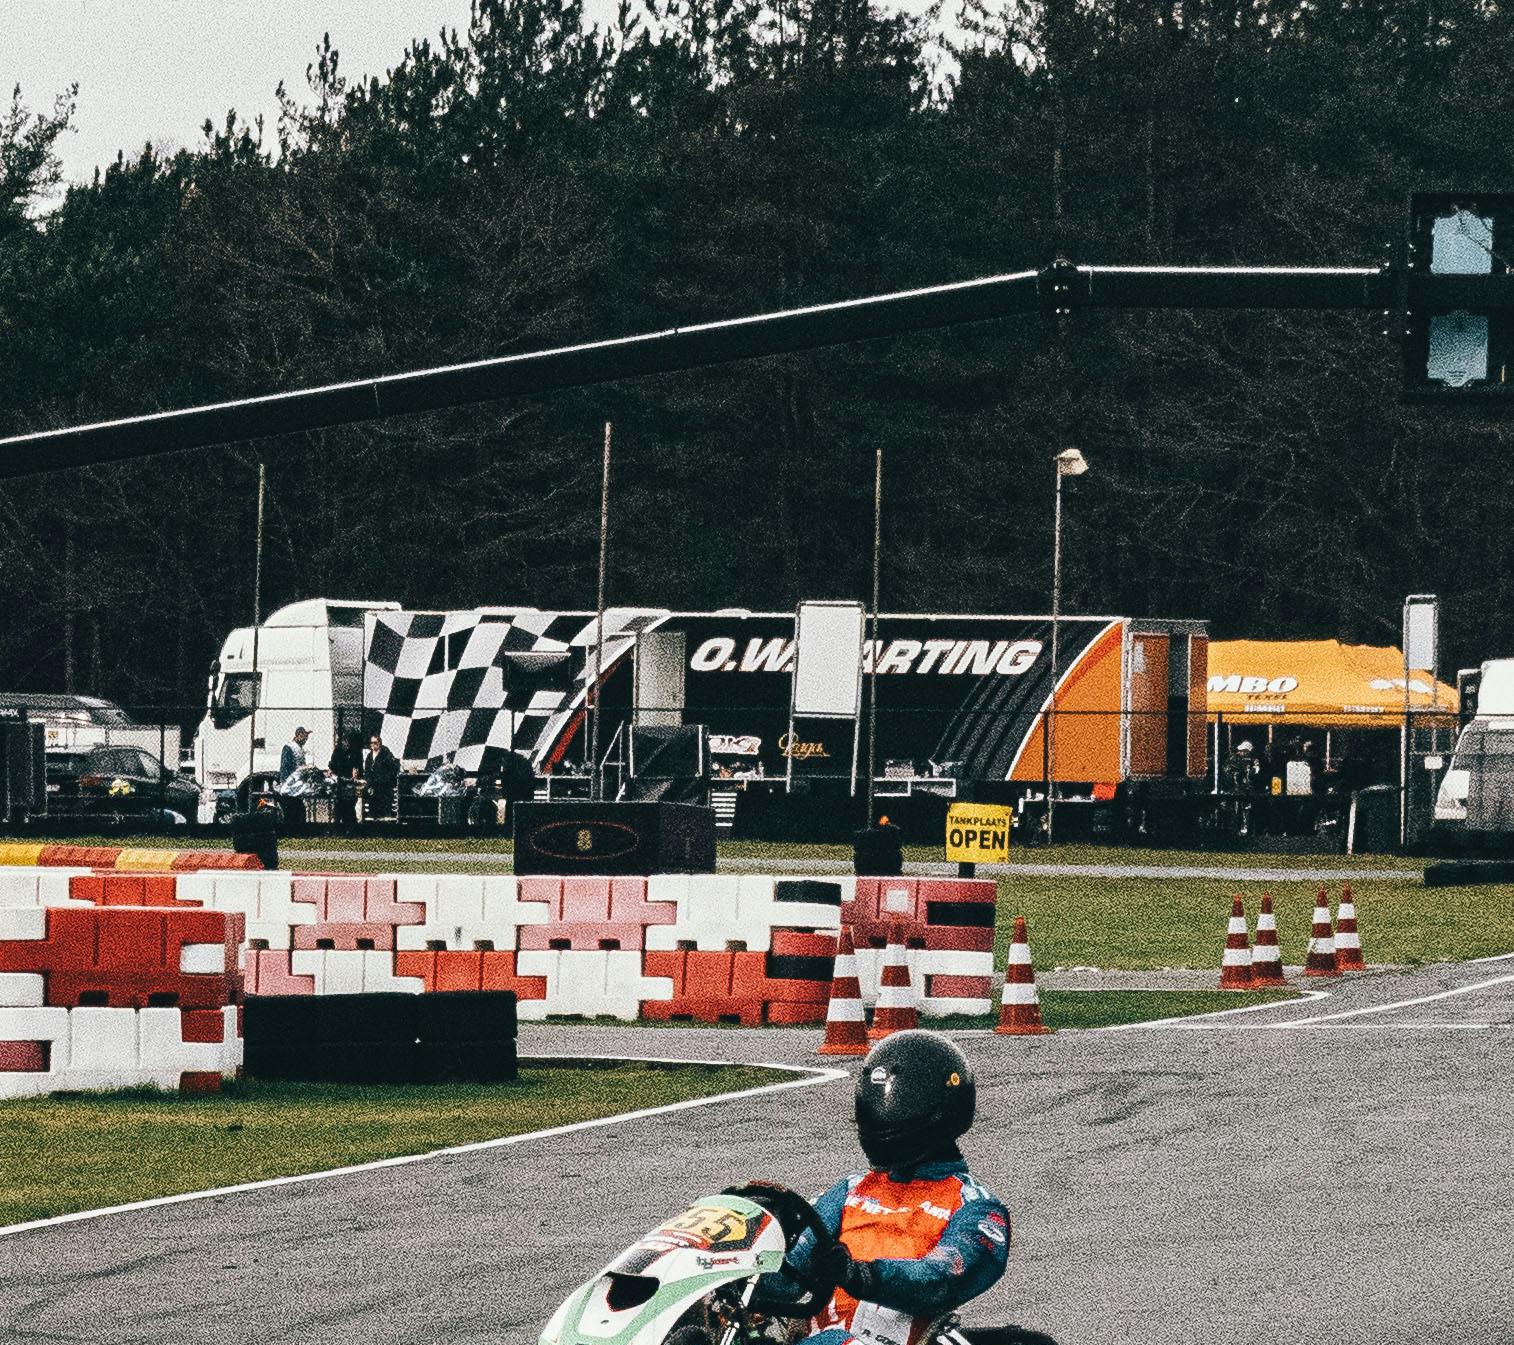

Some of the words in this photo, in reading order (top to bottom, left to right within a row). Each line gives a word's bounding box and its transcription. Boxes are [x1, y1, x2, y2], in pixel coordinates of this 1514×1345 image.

[862, 638, 1043, 675] ARTING
[949, 815, 1007, 827] TANKPLAATS
[950, 829, 1006, 850] OPEN
[674, 1207, 745, 1241] 55
